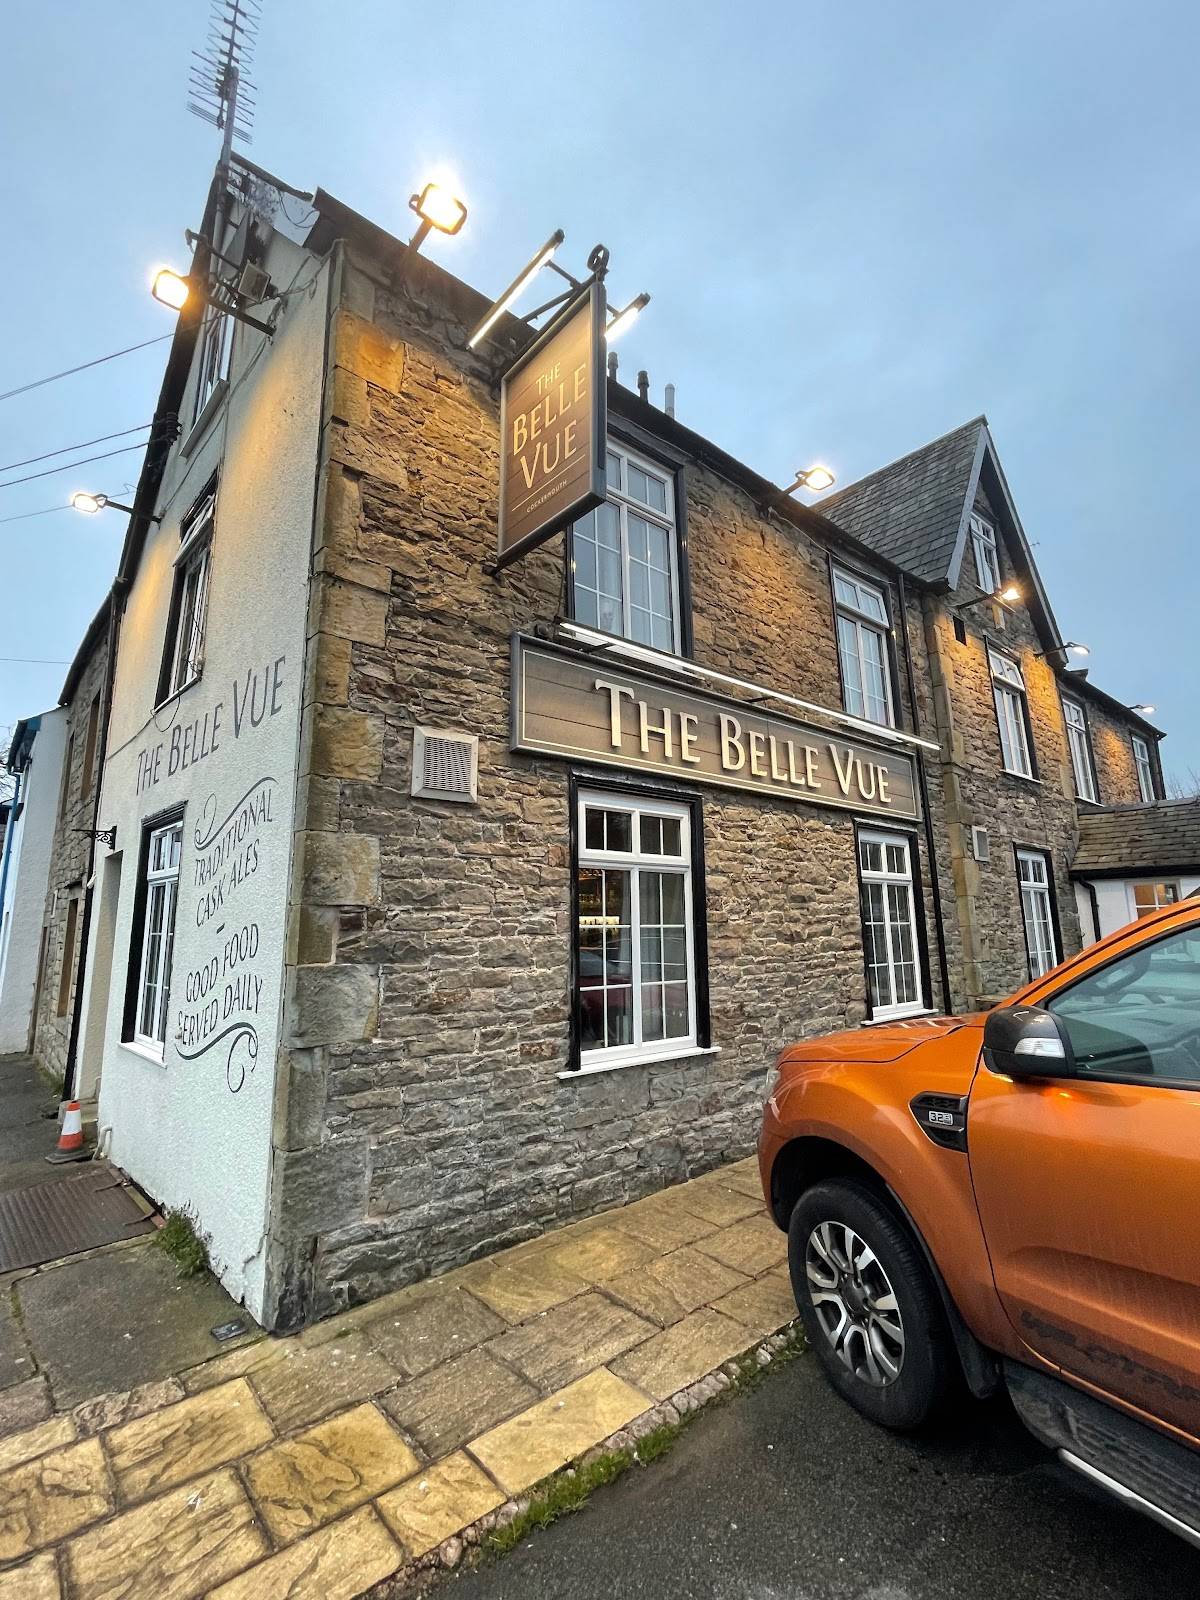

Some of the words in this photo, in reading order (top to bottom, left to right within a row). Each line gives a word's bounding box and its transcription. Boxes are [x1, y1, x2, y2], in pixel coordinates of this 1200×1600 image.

[513, 363, 587, 456] BELLE
[535, 361, 561, 396] THE
[519, 419, 578, 489] VUE
[136, 743, 164, 796] THE
[168, 702, 224, 777] BELLE
[233, 655, 286, 739] VUE
[594, 678, 701, 763] THE
[719, 712, 821, 788] BELLE
[829, 743, 892, 803] VUE
[194, 788, 273, 886] TRADITIONAL
[197, 873, 226, 928] CASK
[228, 838, 259, 895] ALES
[186, 956, 218, 1002] GOOD
[223, 923, 259, 977] FOOD
[223, 973, 263, 1020] DAILY
